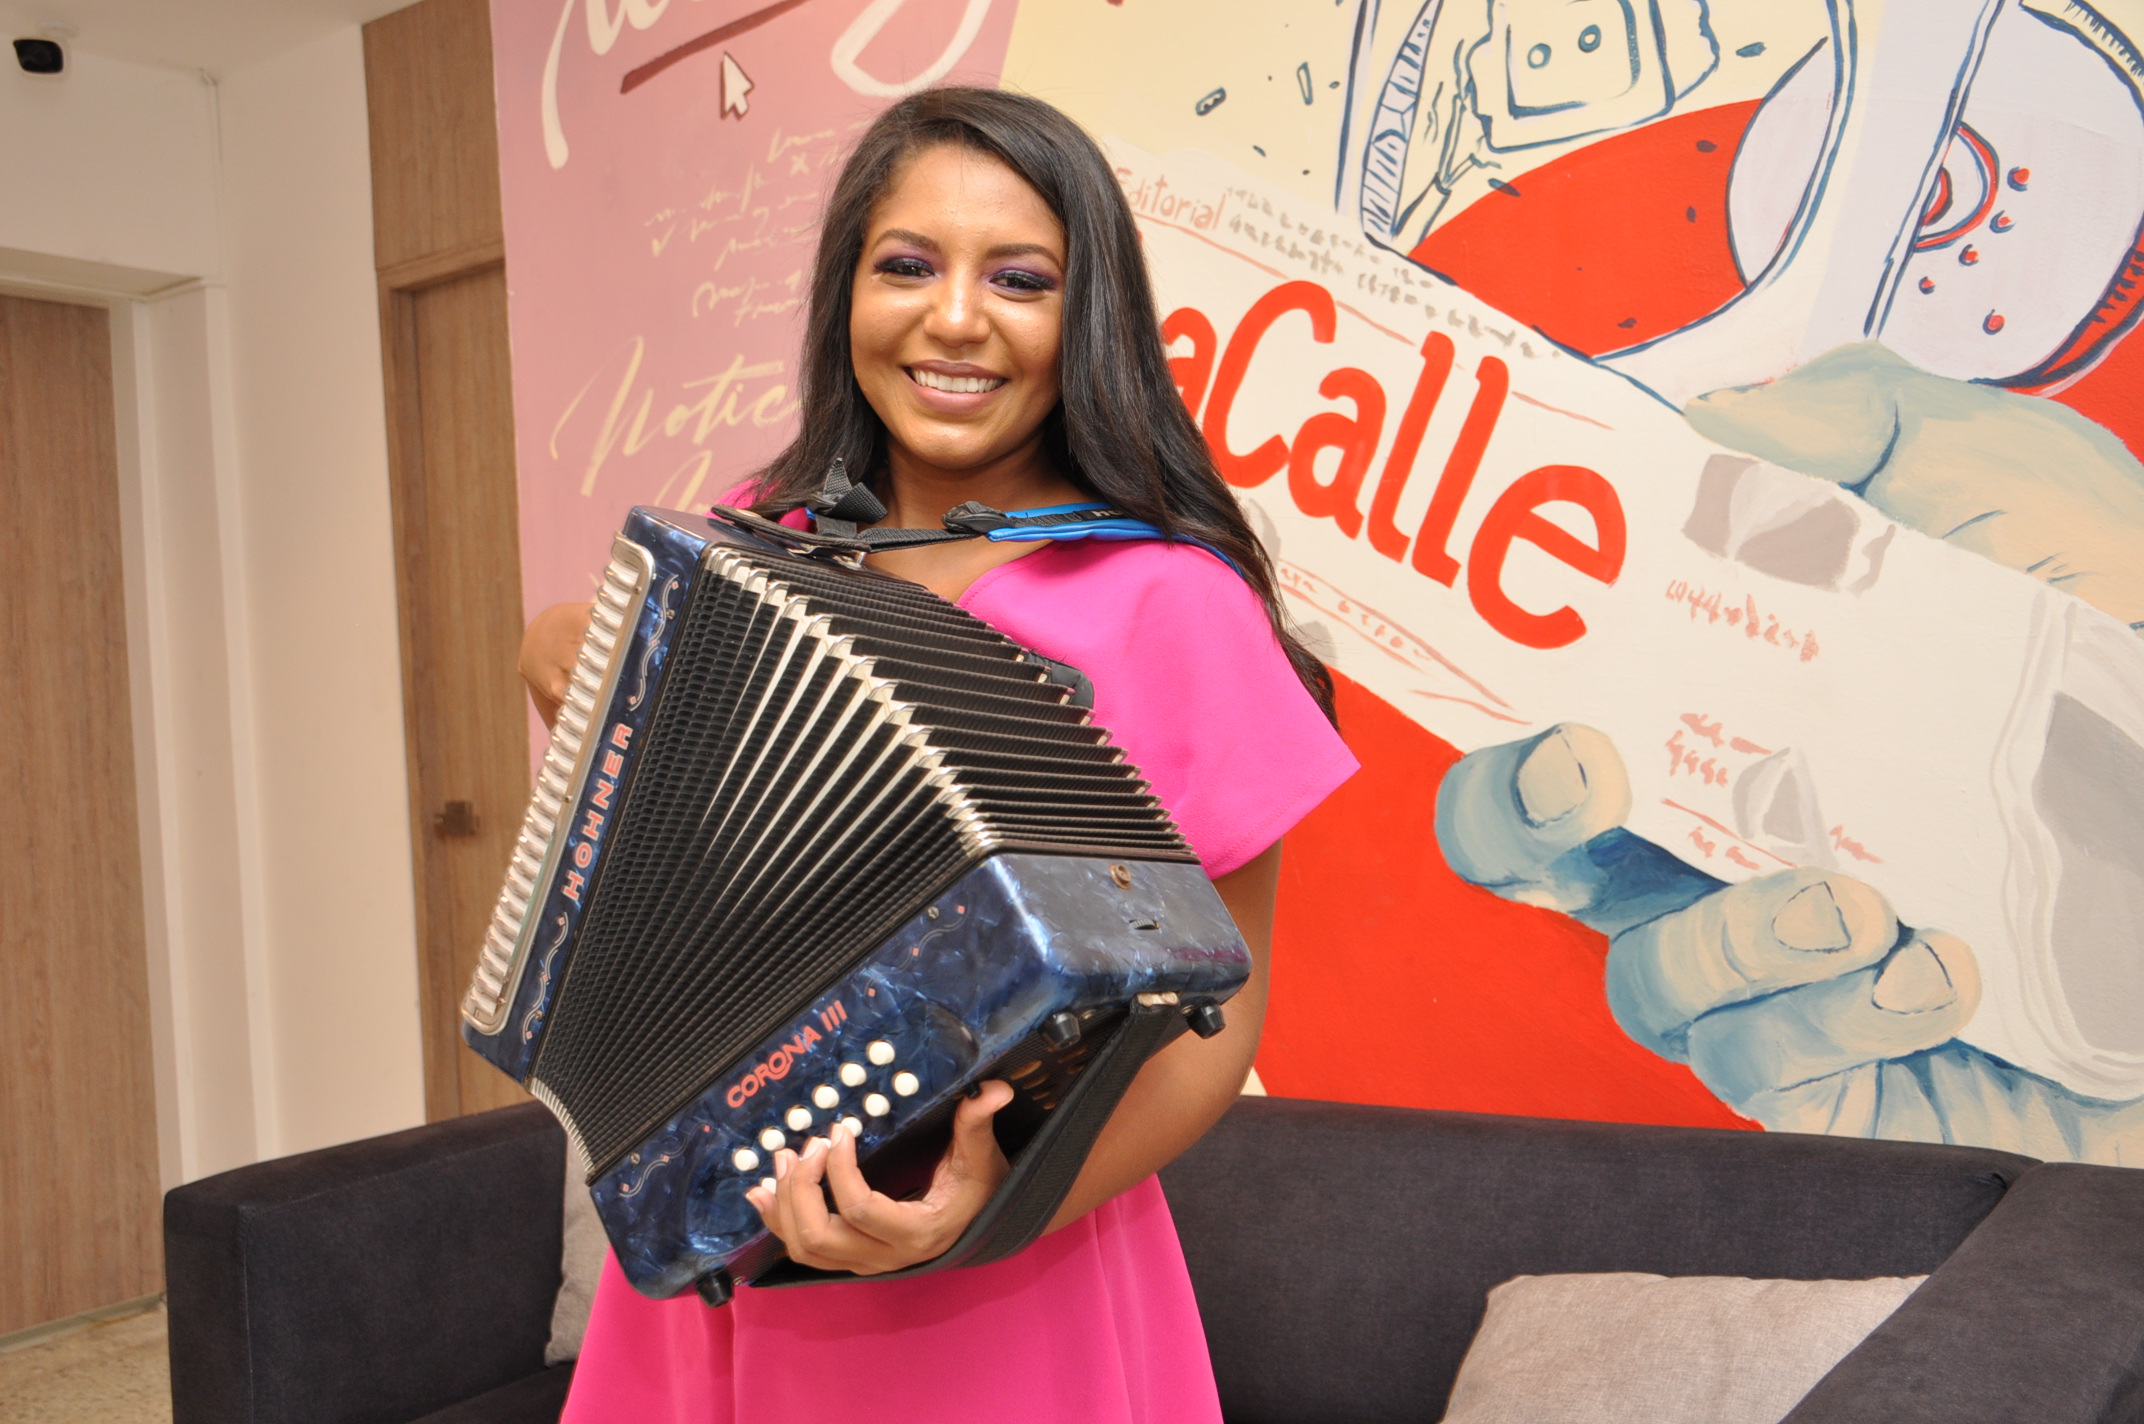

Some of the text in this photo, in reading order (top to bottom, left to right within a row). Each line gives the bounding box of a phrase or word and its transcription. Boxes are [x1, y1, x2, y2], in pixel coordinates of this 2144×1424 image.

[1115, 166, 1227, 231] Editorial
[1159, 280, 1627, 650] aCalle
[561, 722, 634, 901] HOHNER
[726, 1000, 848, 1109] CORONA III
